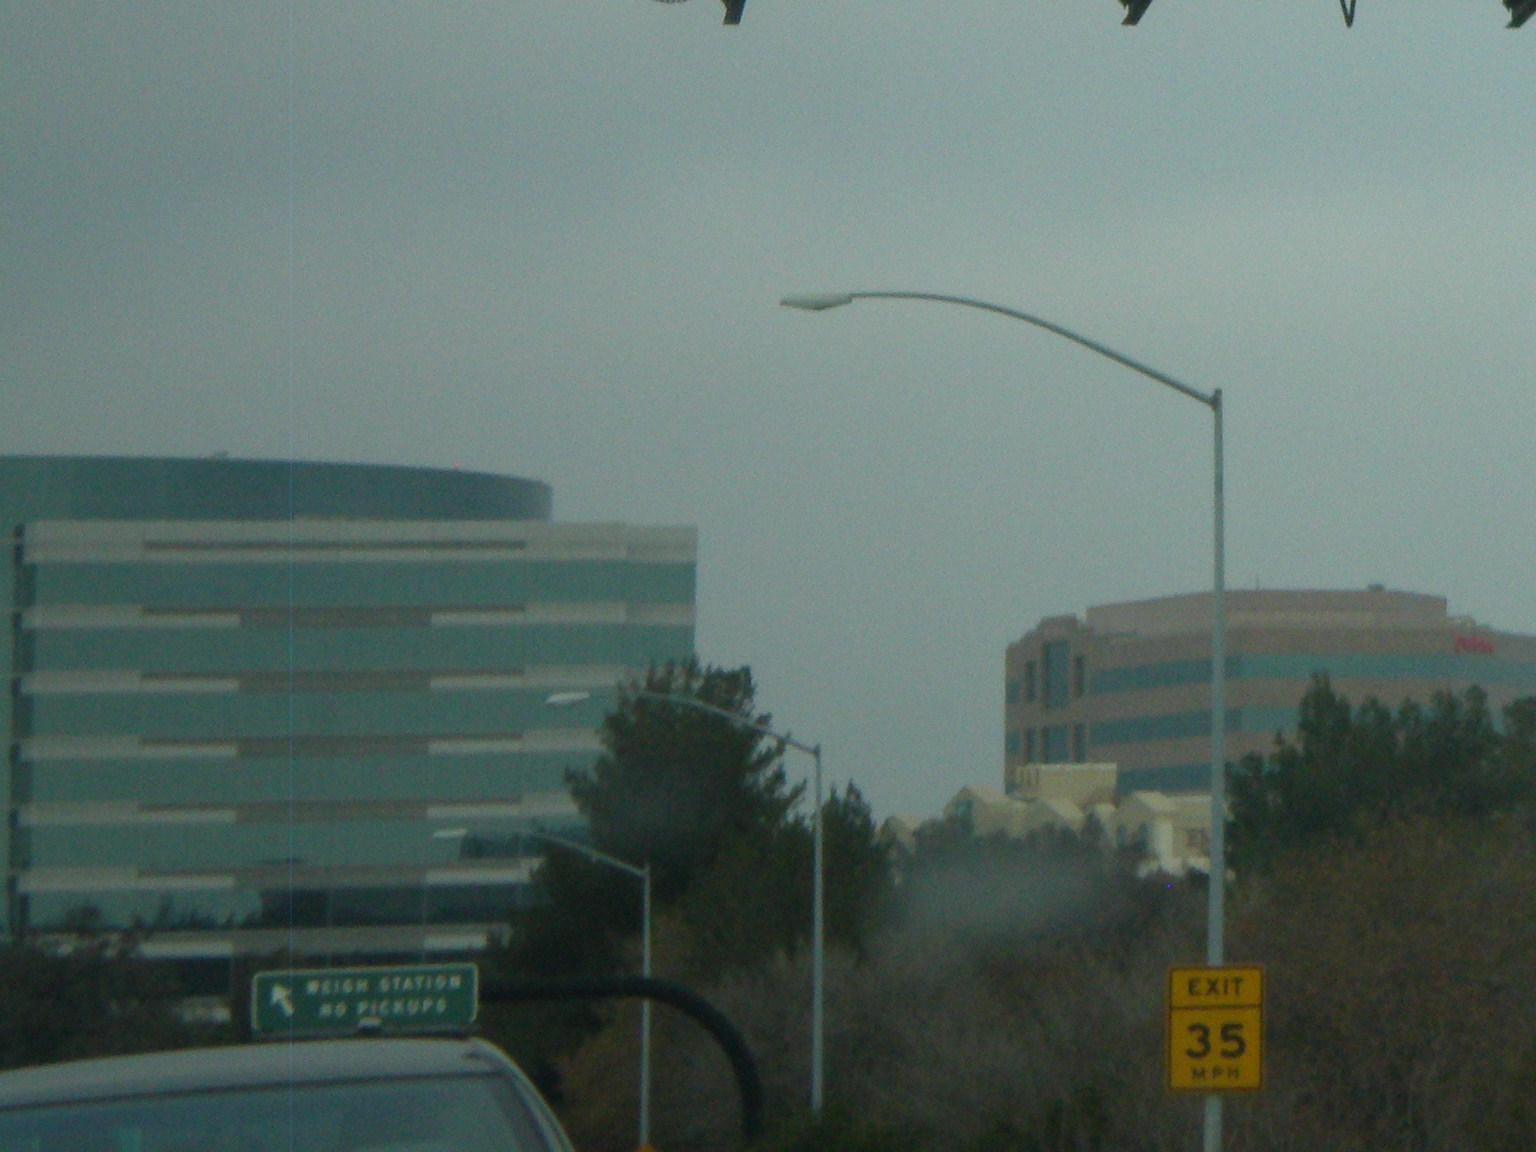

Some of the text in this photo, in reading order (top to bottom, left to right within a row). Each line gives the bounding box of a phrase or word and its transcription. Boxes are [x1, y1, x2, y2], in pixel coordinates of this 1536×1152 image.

[379, 974, 463, 993] STATION
[1188, 976, 1243, 997] EXIT
[357, 997, 448, 1017] PICKUPS
[1185, 1021, 1247, 1060] 35
[1191, 1065, 1241, 1081] MPH
